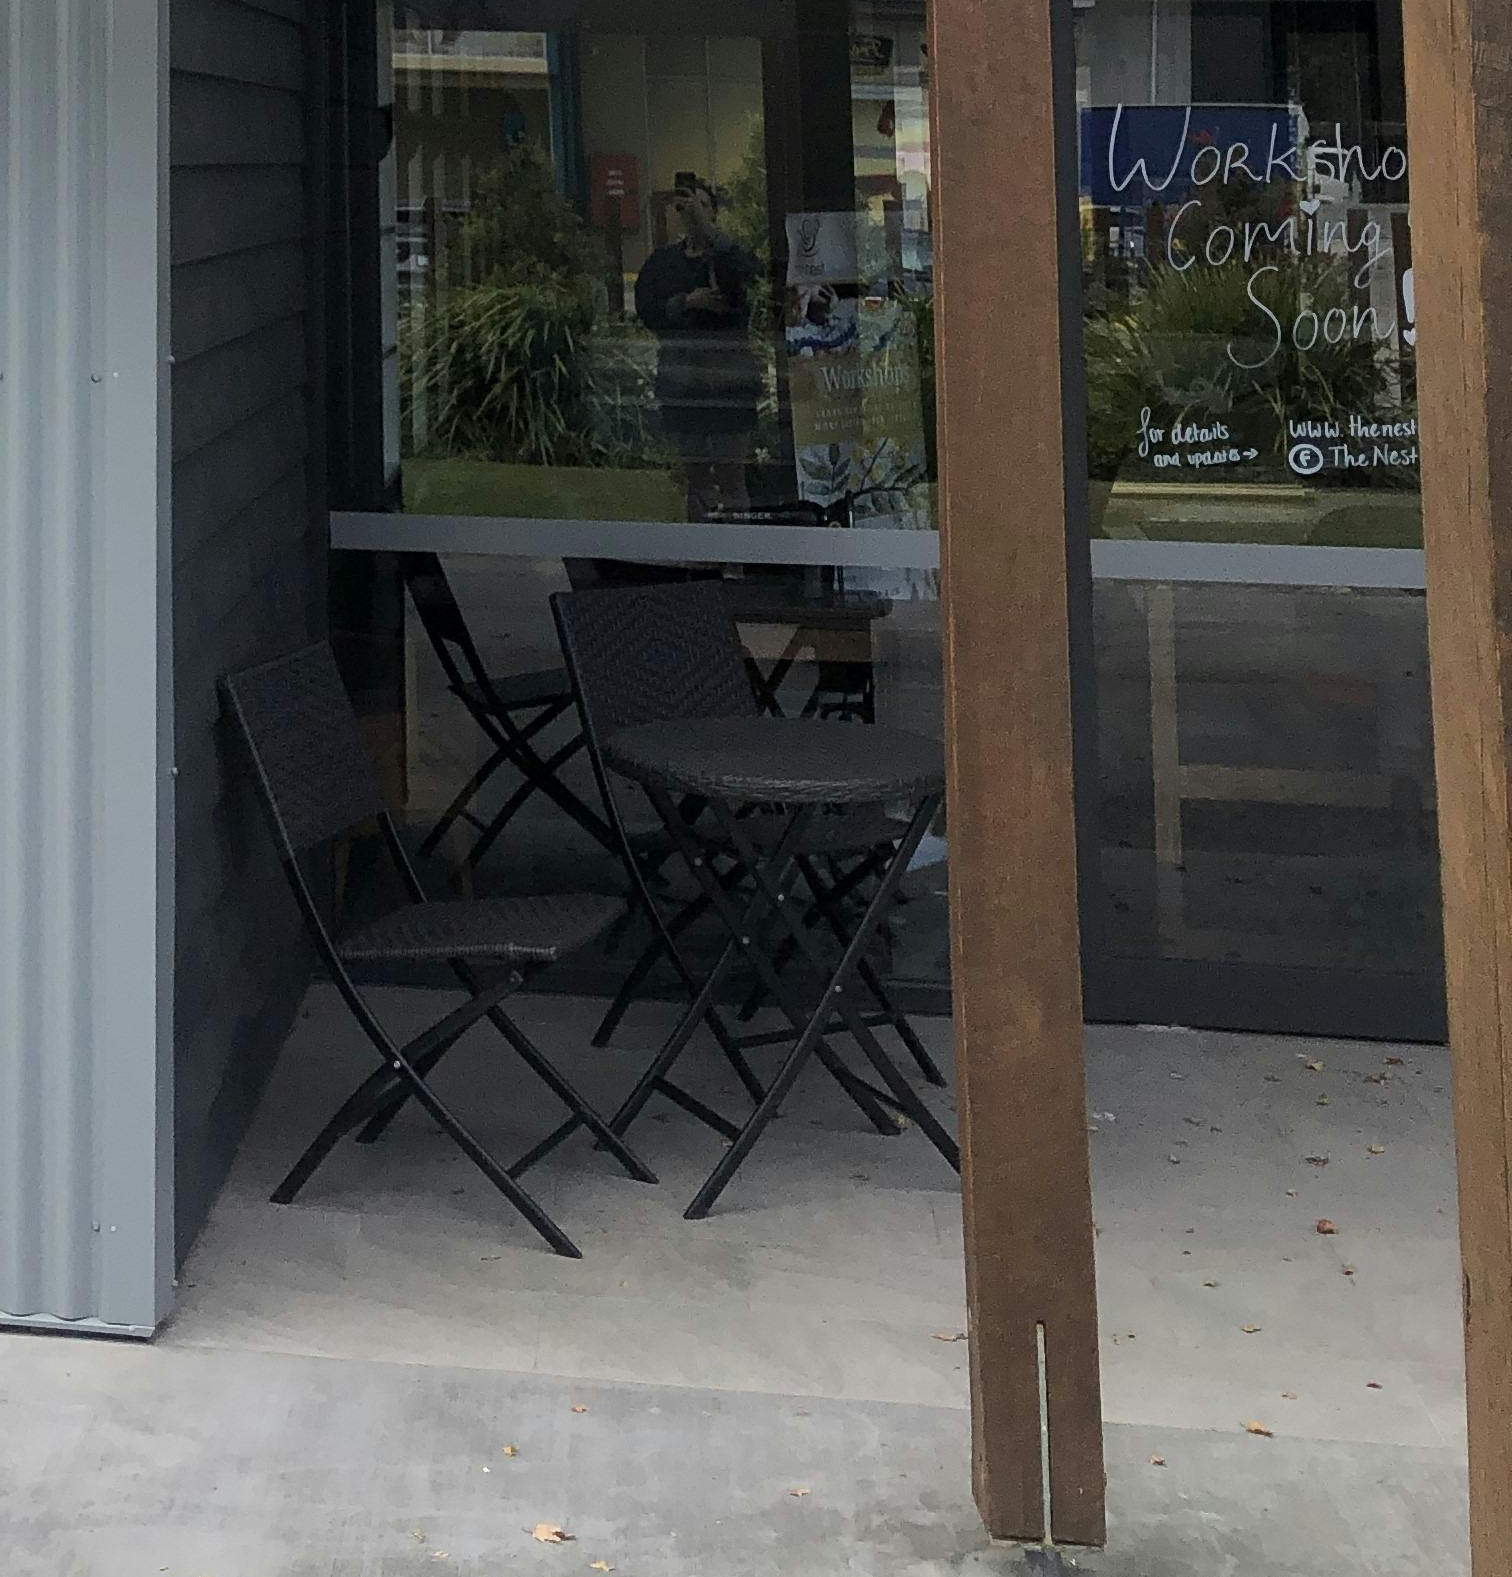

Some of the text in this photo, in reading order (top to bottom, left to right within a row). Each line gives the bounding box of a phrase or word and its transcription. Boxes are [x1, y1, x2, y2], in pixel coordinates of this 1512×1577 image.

[1167, 200, 1393, 289] Coming
[1136, 406, 1230, 458] for details
[1153, 452, 1182, 467] and
[1328, 443, 1369, 468] The
[1372, 443, 1418, 467] Nest
